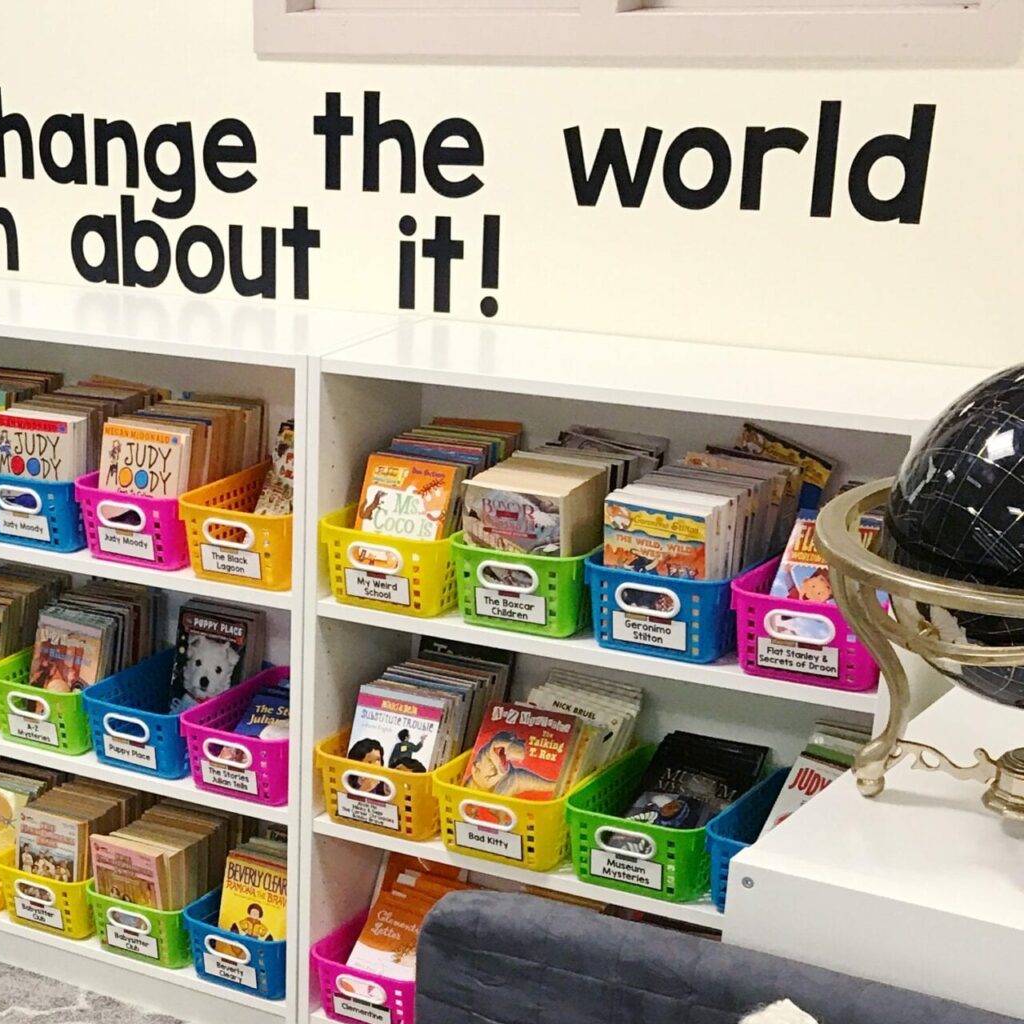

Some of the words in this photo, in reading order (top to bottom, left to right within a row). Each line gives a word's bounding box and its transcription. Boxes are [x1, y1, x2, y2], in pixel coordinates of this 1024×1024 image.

[314, 91, 485, 199] the
[564, 101, 937, 225] world
[71, 195, 321, 300] about
[399, 215, 501, 318] it!
[14, 431, 60, 459] JUDY
[124, 442, 172, 473] JUDY
[0, 455, 61, 480] MOODY
[106, 463, 172, 495] MOODY
[2, 519, 19, 531] Judy
[19, 520, 44, 534] Moody
[373, 507, 416, 535] Coco
[104, 533, 121, 545] Judy
[122, 536, 149, 549] Moody
[211, 551, 226, 561] The
[227, 553, 249, 565] Black
[216, 561, 246, 575] Lagoon
[356, 576, 371, 588] My
[371, 578, 398, 592] Weird
[364, 587, 392, 600] School
[484, 596, 502, 607] The
[502, 598, 536, 611] Boxcar
[491, 606, 529, 620] Children
[193, 616, 219, 632] PUPPY
[220, 623, 245, 638] PLACE
[624, 619, 672, 636] Geronimo
[632, 630, 664, 645] Stilton
[759, 653, 795, 667] Secrets
[795, 658, 807, 669] of
[808, 660, 838, 674] Droon
[766, 646, 784, 657] Flat
[784, 649, 821, 664] Stanley
[821, 654, 829, 663] &
[255, 704, 273, 715] The
[552, 700, 572, 713] NICK
[572, 707, 596, 721] BRUEL
[27, 723, 39, 732] A-Z
[491, 705, 521, 725] A-Z
[520, 710, 572, 733] Mysteries
[17, 728, 51, 743] Mysteries
[542, 730, 554, 738] The
[108, 743, 131, 756] Puppy
[130, 748, 151, 761] Place
[528, 736, 565, 753] Talking
[529, 749, 538, 758] T.
[538, 750, 558, 762] Rex
[208, 766, 223, 777] The
[222, 768, 250, 783] Stories
[212, 776, 233, 787] Julian
[233, 780, 249, 791] Tells
[468, 832, 485, 843] Bad
[486, 835, 509, 850] Kitty
[227, 861, 265, 889] BEVERLY
[606, 858, 647, 875] Museum
[601, 867, 650, 886] Mysteries
[225, 880, 256, 898] RAMONA
[21, 902, 55, 918] Babysitter
[32, 914, 46, 923] Club
[113, 931, 150, 948] Babysitter
[370, 922, 402, 941] Letter
[125, 942, 140, 952] Club
[216, 961, 244, 977] Beverly
[218, 969, 243, 984] Cleary
[341, 1002, 384, 1022] Clementine
